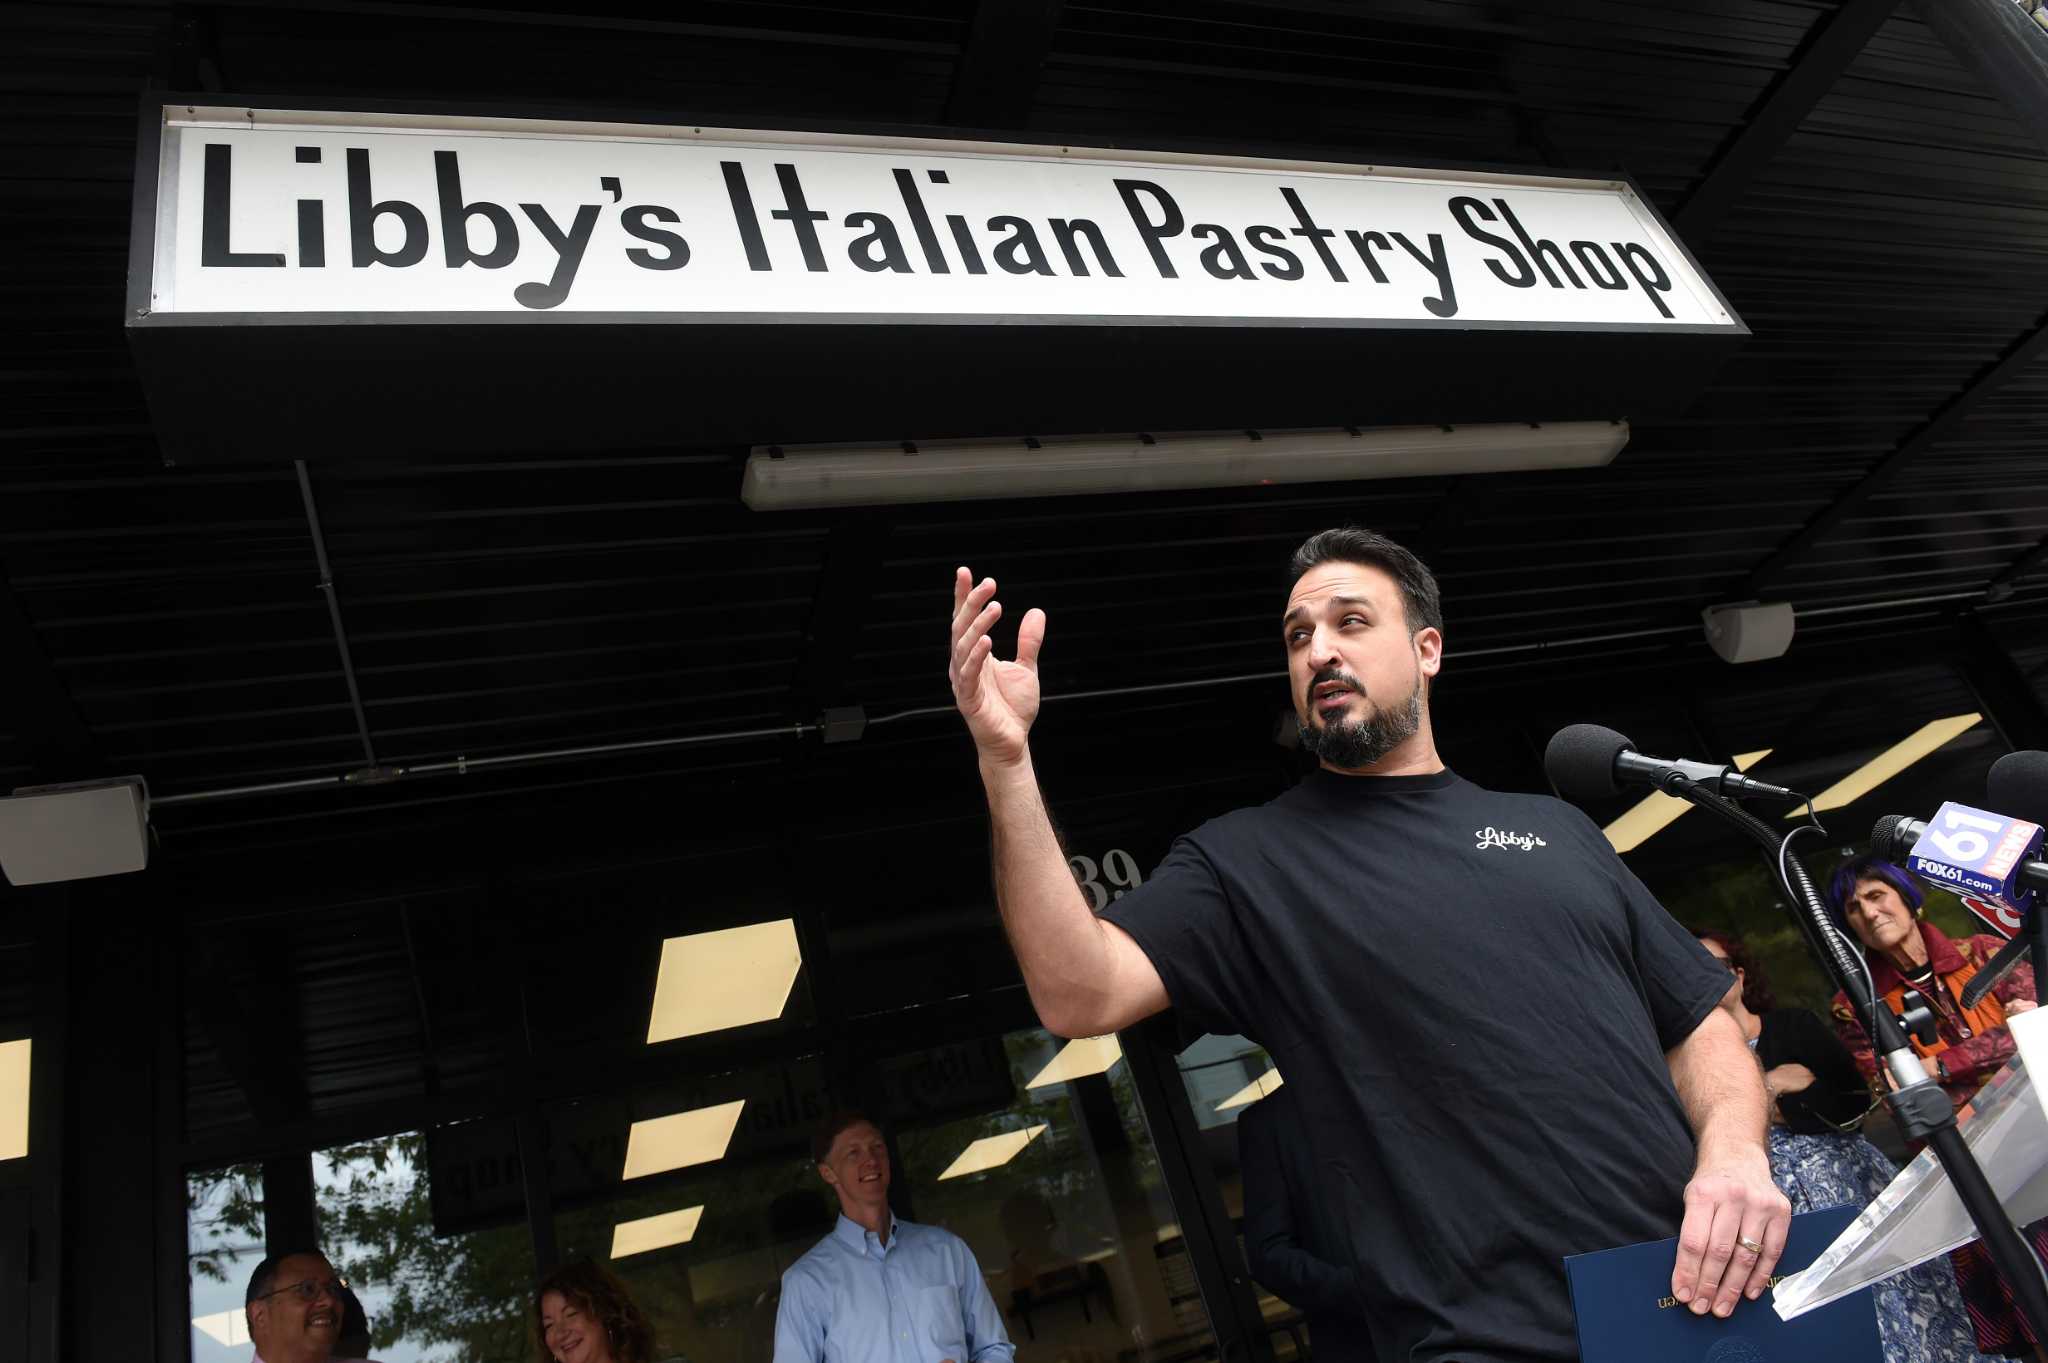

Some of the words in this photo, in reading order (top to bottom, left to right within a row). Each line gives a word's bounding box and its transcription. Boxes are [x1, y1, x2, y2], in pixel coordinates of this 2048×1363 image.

[201, 144, 691, 309] Libby's
[720, 161, 1126, 277] Italian
[1112, 178, 1458, 318] Pastry
[1448, 196, 1676, 319] Shop
[1475, 826, 1547, 851] Libby's
[1930, 809, 2003, 862] 61
[1985, 822, 2034, 873] NEWS
[1916, 858, 1994, 893] FOX61.com
